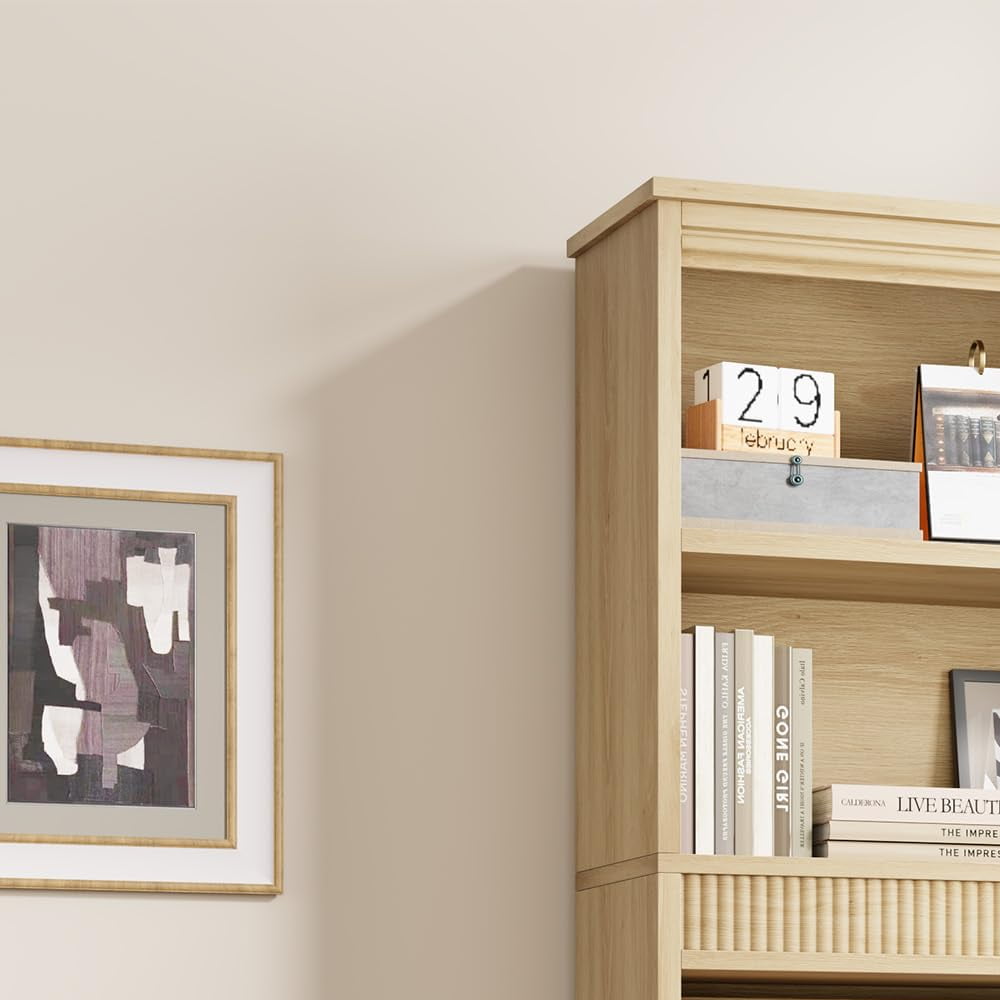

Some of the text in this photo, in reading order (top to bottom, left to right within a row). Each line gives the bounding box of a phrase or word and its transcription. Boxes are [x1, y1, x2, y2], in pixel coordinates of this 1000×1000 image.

[897, 796, 938, 812] LIVE
[941, 828, 961, 837] THE
[939, 848, 959, 857] THE
